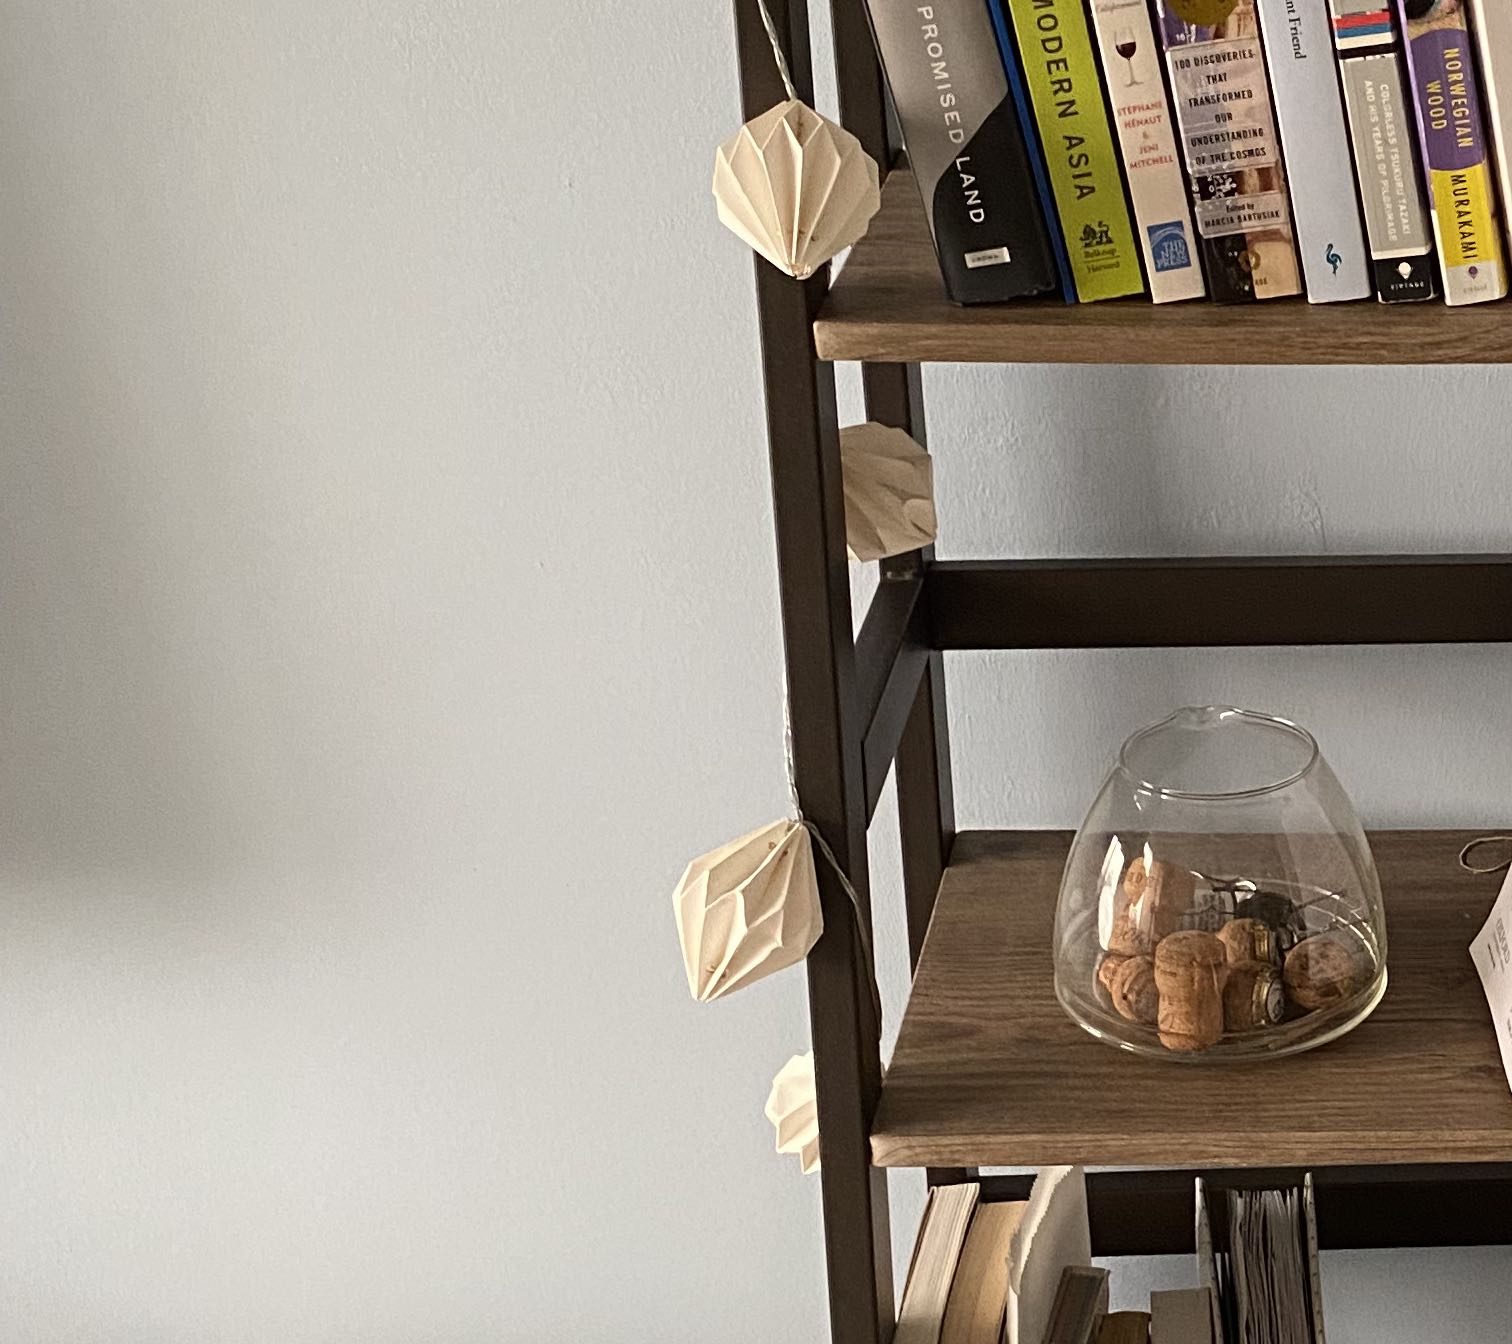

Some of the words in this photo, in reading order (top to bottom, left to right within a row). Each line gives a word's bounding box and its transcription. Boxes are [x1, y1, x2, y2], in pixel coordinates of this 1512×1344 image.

[1288, 15, 1307, 60] Friend
[1188, 89, 1253, 109] TRANSFORMED
[1205, 72, 1228, 85] THAT
[1443, 47, 1474, 148] NORWEGIAN
[917, 5, 965, 144] PROMISED
[955, 155, 985, 223] LAND
[1214, 112, 1233, 123] OUR
[1426, 79, 1447, 131] WOOD
[1190, 127, 1264, 148] UNDERSTANDING
[1372, 125, 1385, 161] YEARS
[1062, 134, 1096, 200] ASIA
[1450, 172, 1478, 261] MURAKAMI
